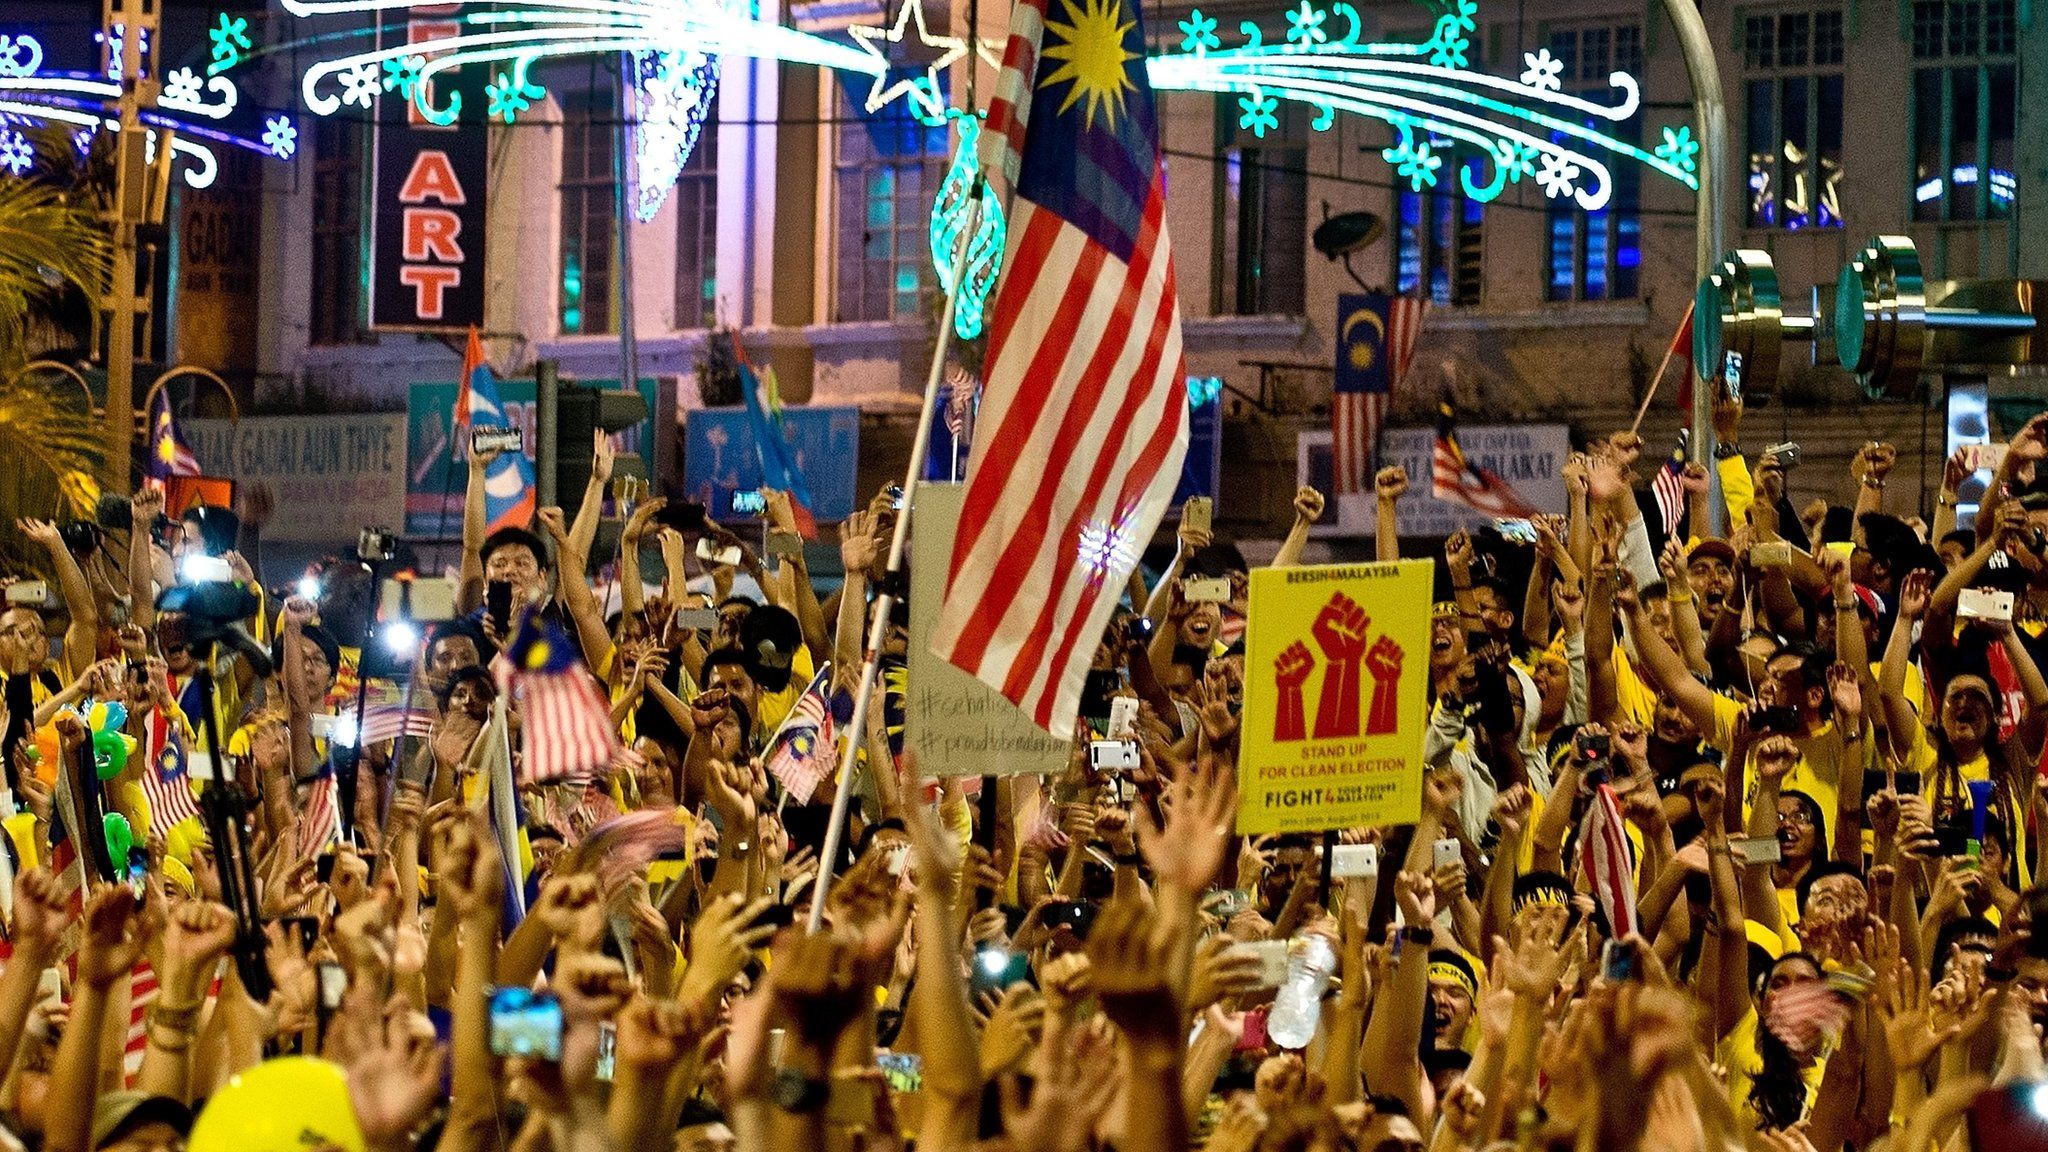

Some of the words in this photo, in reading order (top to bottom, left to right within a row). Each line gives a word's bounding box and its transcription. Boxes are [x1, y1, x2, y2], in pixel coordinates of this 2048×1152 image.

[241, 428, 297, 475] GADAI
[302, 426, 340, 474] AUN
[346, 425, 393, 472] THYE
[1301, 745, 1345, 760] STAND
[1349, 743, 1367, 756] UP
[1259, 766, 1287, 780] FOR
[1291, 762, 1336, 778] CLEAN
[1340, 757, 1405, 774] ELECTION
[1337, 794, 1383, 804] MALAYSIA
